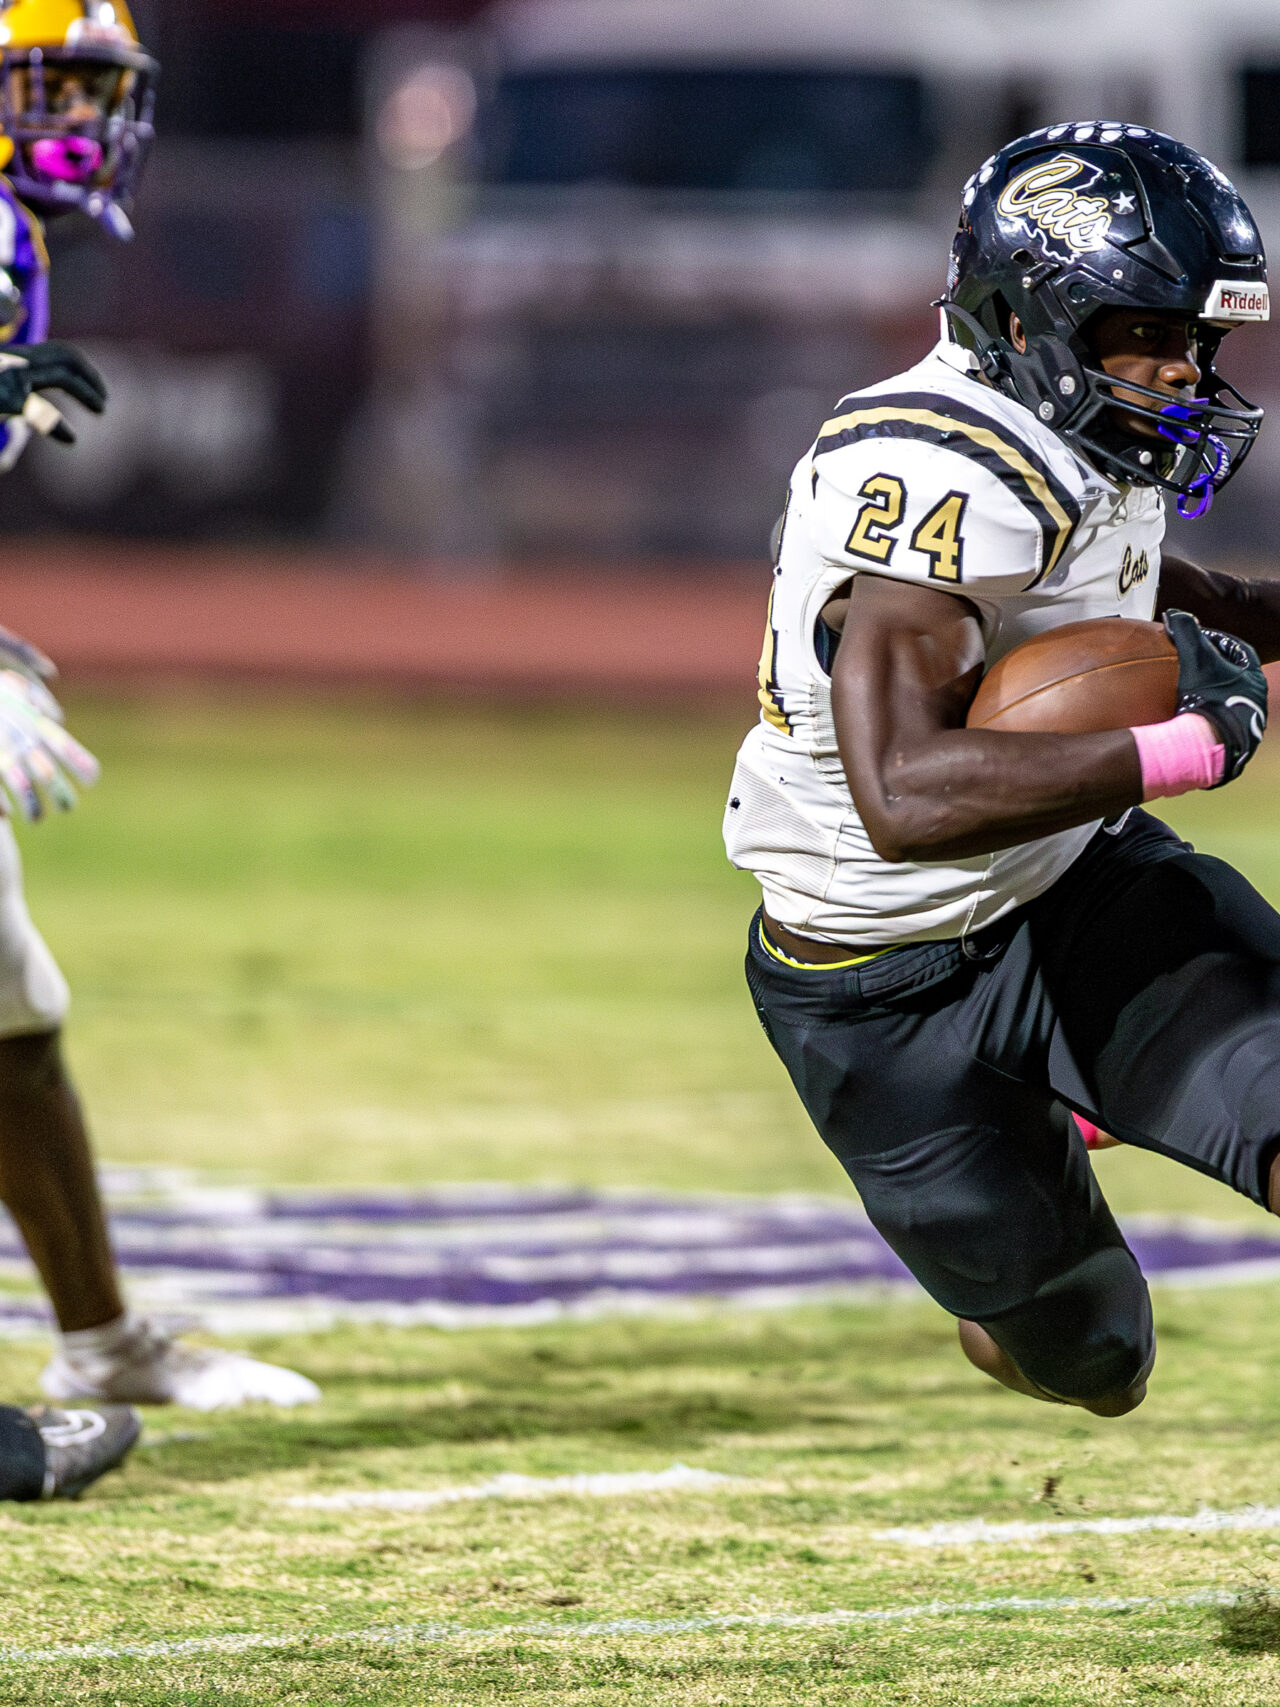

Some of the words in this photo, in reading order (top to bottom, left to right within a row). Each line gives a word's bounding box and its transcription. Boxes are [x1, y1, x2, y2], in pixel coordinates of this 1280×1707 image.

[998, 159, 1112, 251] Cats
[1220, 291, 1268, 310] Riddell
[845, 472, 969, 584] 24
[1118, 544, 1149, 595] Cats
